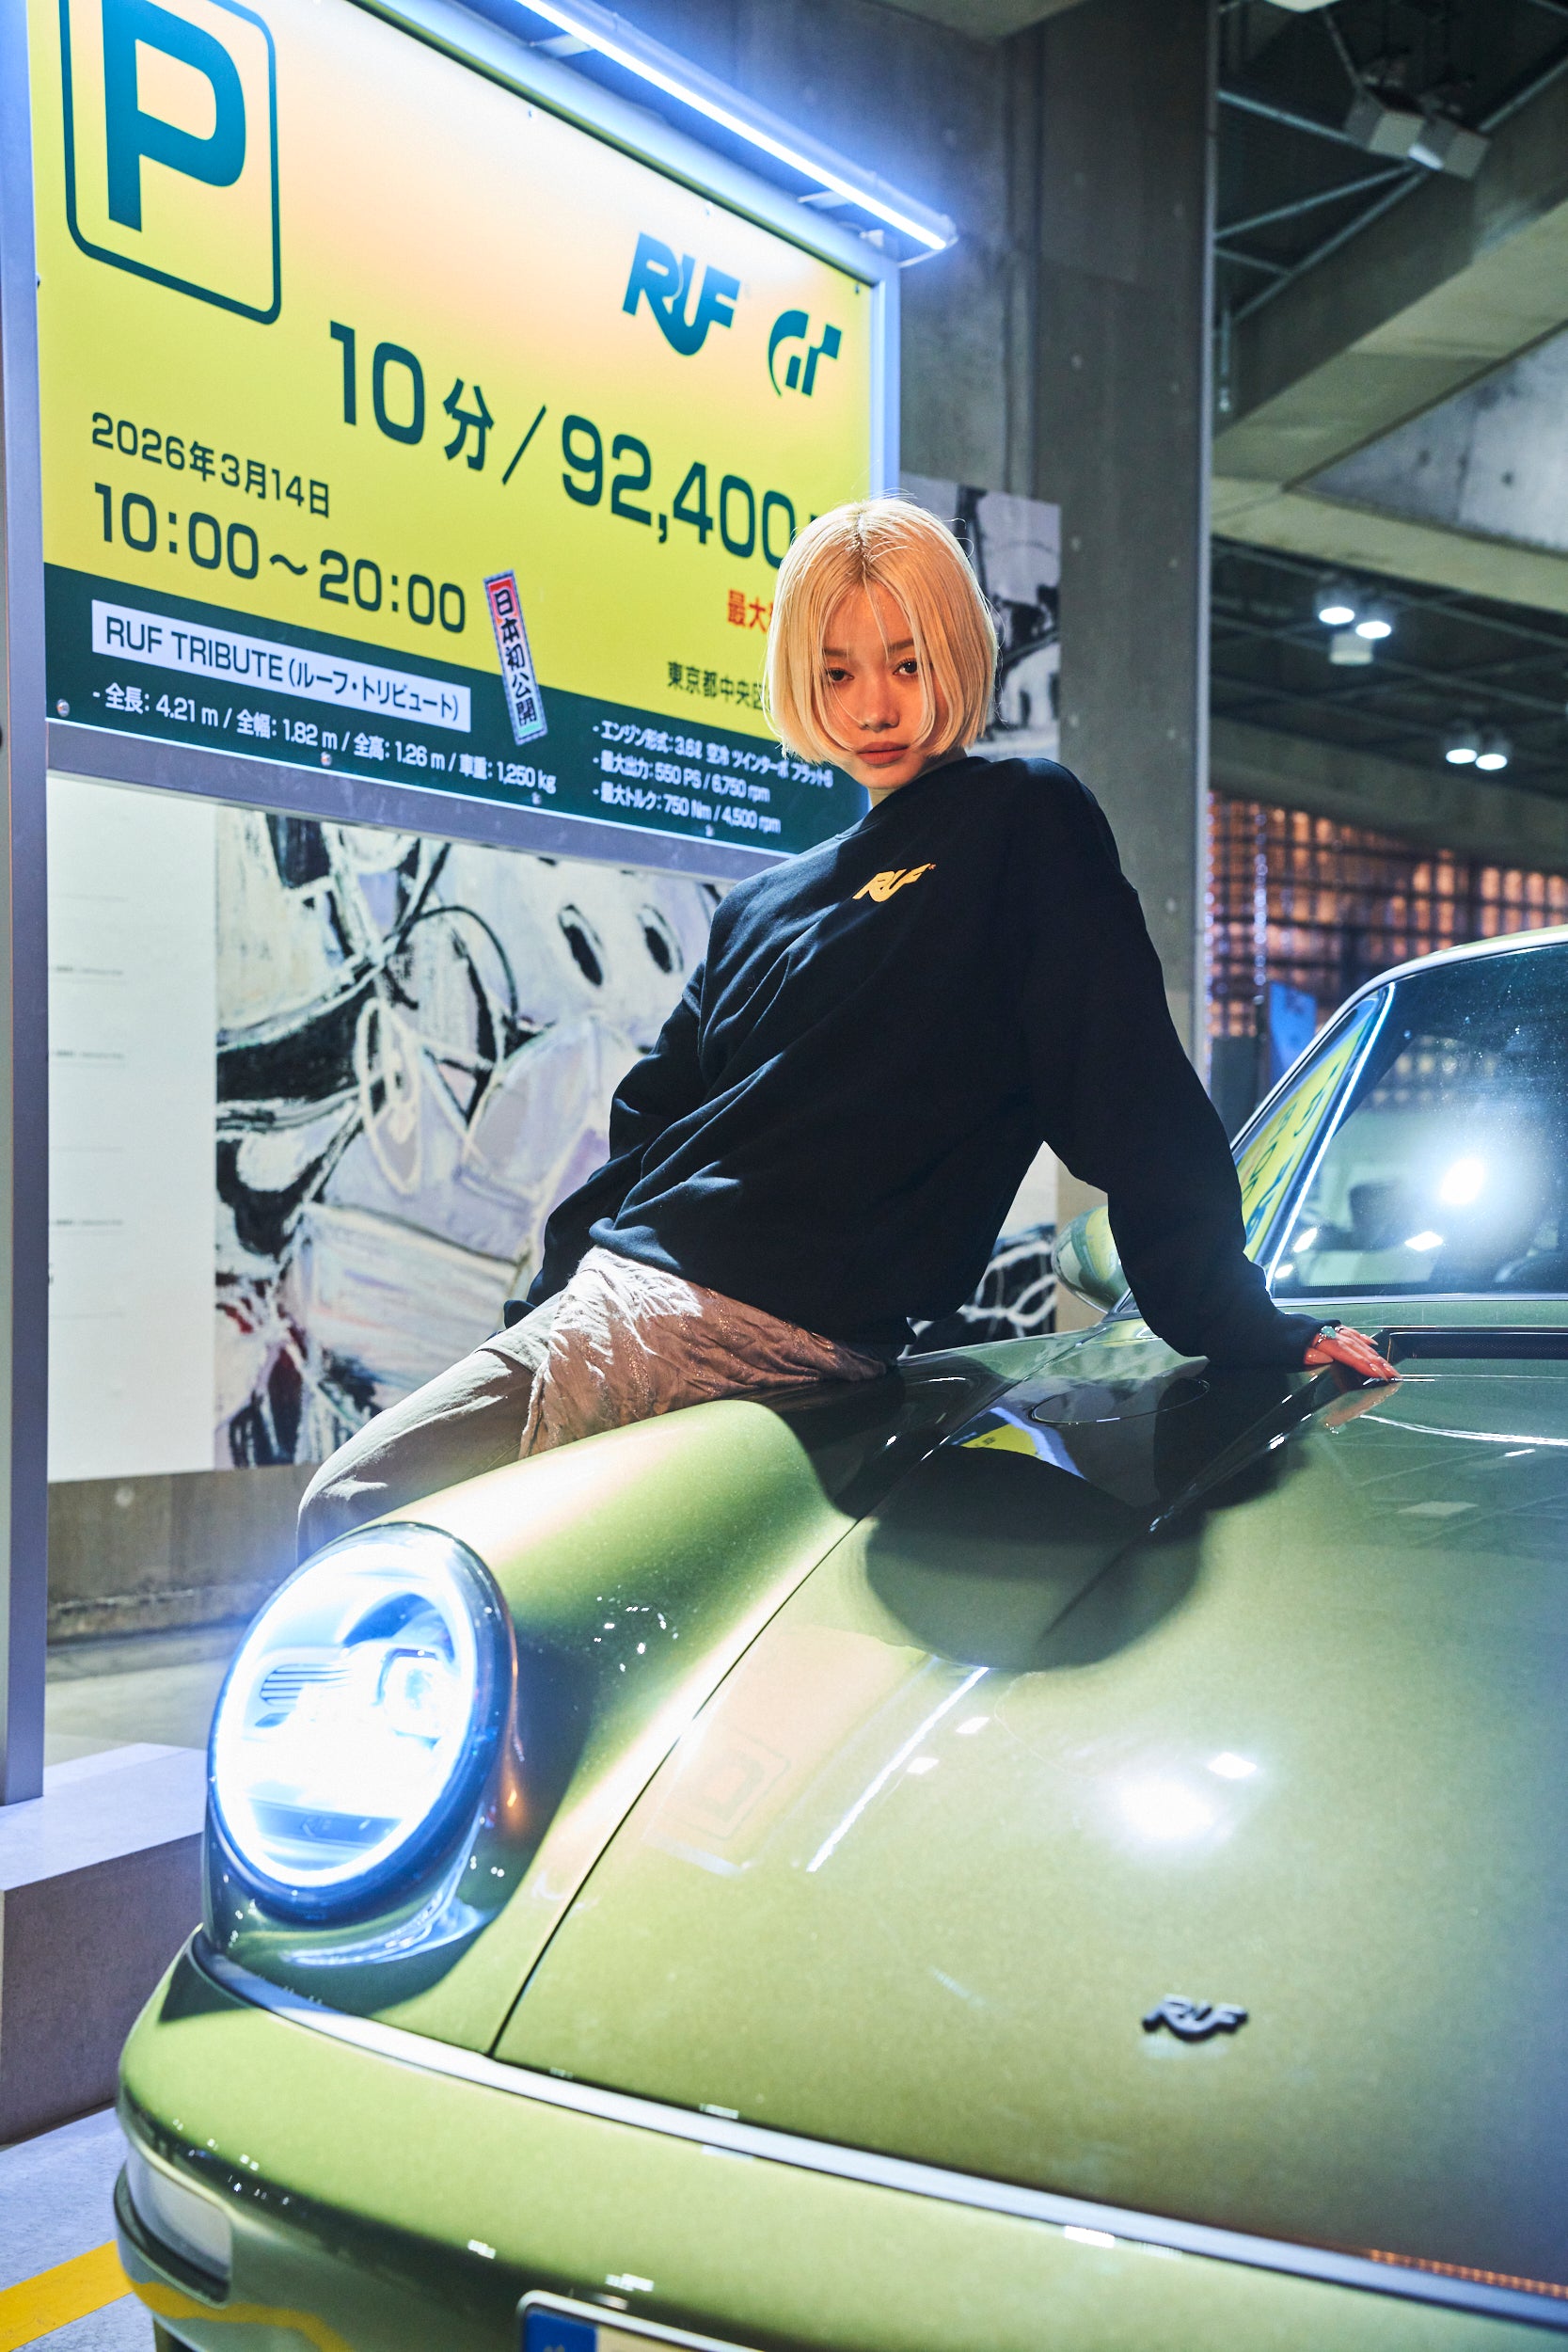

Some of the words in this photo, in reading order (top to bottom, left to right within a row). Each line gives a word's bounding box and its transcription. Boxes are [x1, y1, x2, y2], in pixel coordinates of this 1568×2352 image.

[102, 0, 246, 232] P
[623, 231, 741, 357] RUF
[92, 412, 330, 518] 2026年3月14日
[106, 616, 163, 654] RUF
[728, 589, 774, 634] 最大
[494, 589, 538, 727] 日本初公開
[104, 682, 150, 714] 全長:
[156, 694, 195, 723] 4.21
[201, 707, 218, 727] m
[236, 708, 277, 739] 全幅:
[282, 719, 318, 747] 1.82
[322, 732, 338, 751] m
[354, 733, 390, 761] 全高:
[395, 740, 428, 766] 1.26
[431, 753, 446, 771] m
[497, 761, 535, 787] 1,250
[538, 770, 557, 794] kg
[654, 761, 682, 785] 550
[683, 767, 702, 789] PS
[662, 793, 689, 817] 750
[852, 863, 931, 903] RUF
[1142, 1994, 1249, 2044] RUF
